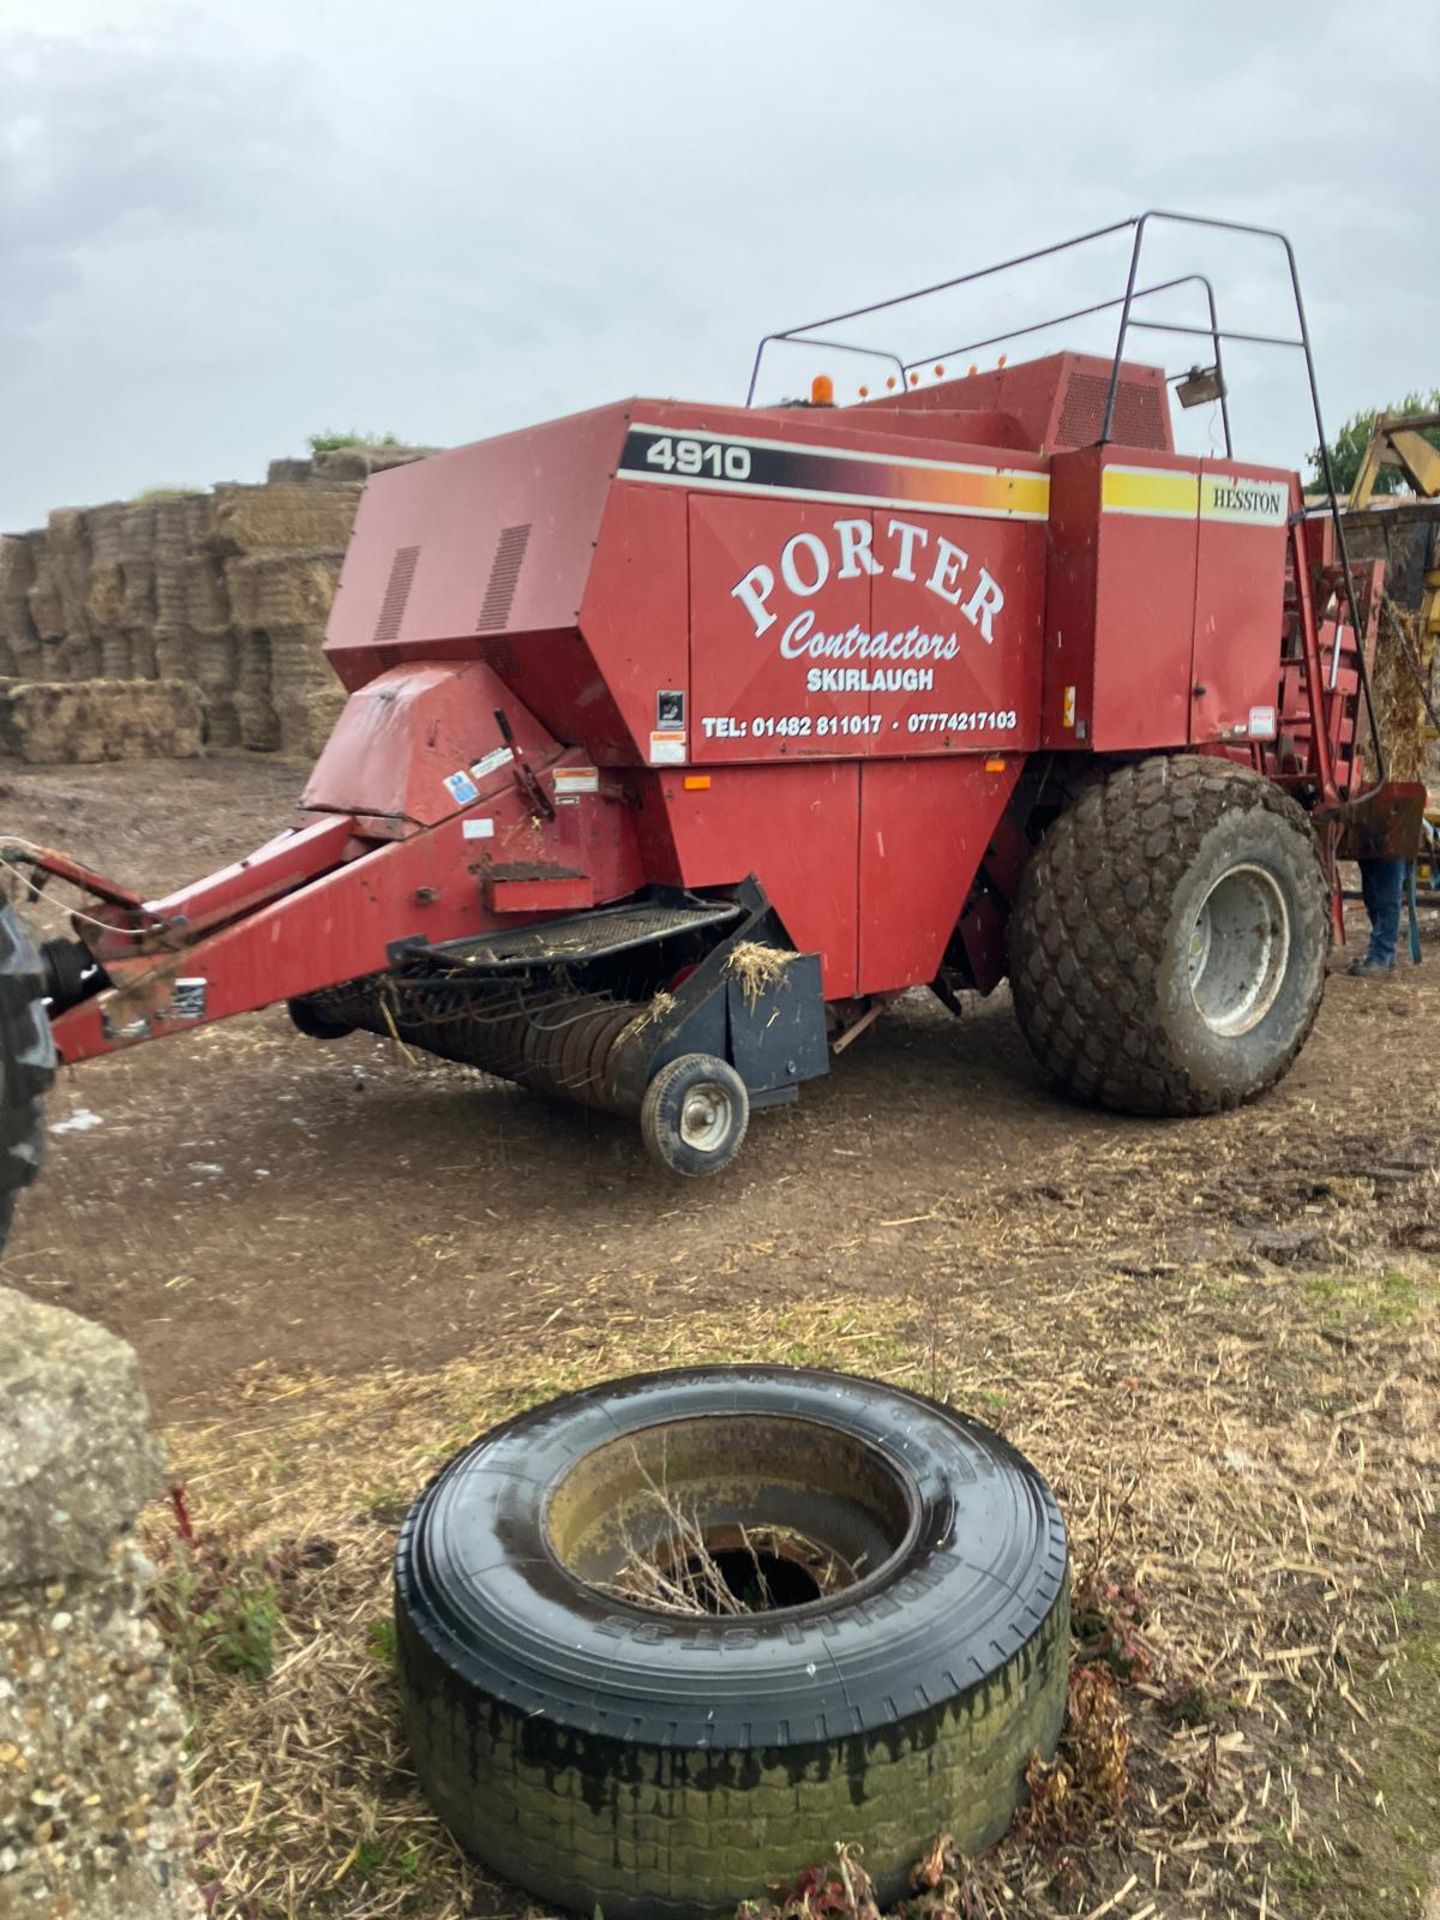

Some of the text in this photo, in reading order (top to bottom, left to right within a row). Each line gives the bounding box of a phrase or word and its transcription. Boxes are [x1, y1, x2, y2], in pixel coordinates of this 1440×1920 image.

[646, 437, 751, 480] 4910
[1213, 486, 1281, 514] HESSTON
[731, 518, 1005, 645] PORTER
[780, 608, 961, 660] Contractors
[807, 667, 934, 693] SKIRLAUGH
[702, 710, 1018, 738] TEL: 01482 811017 07774217103
